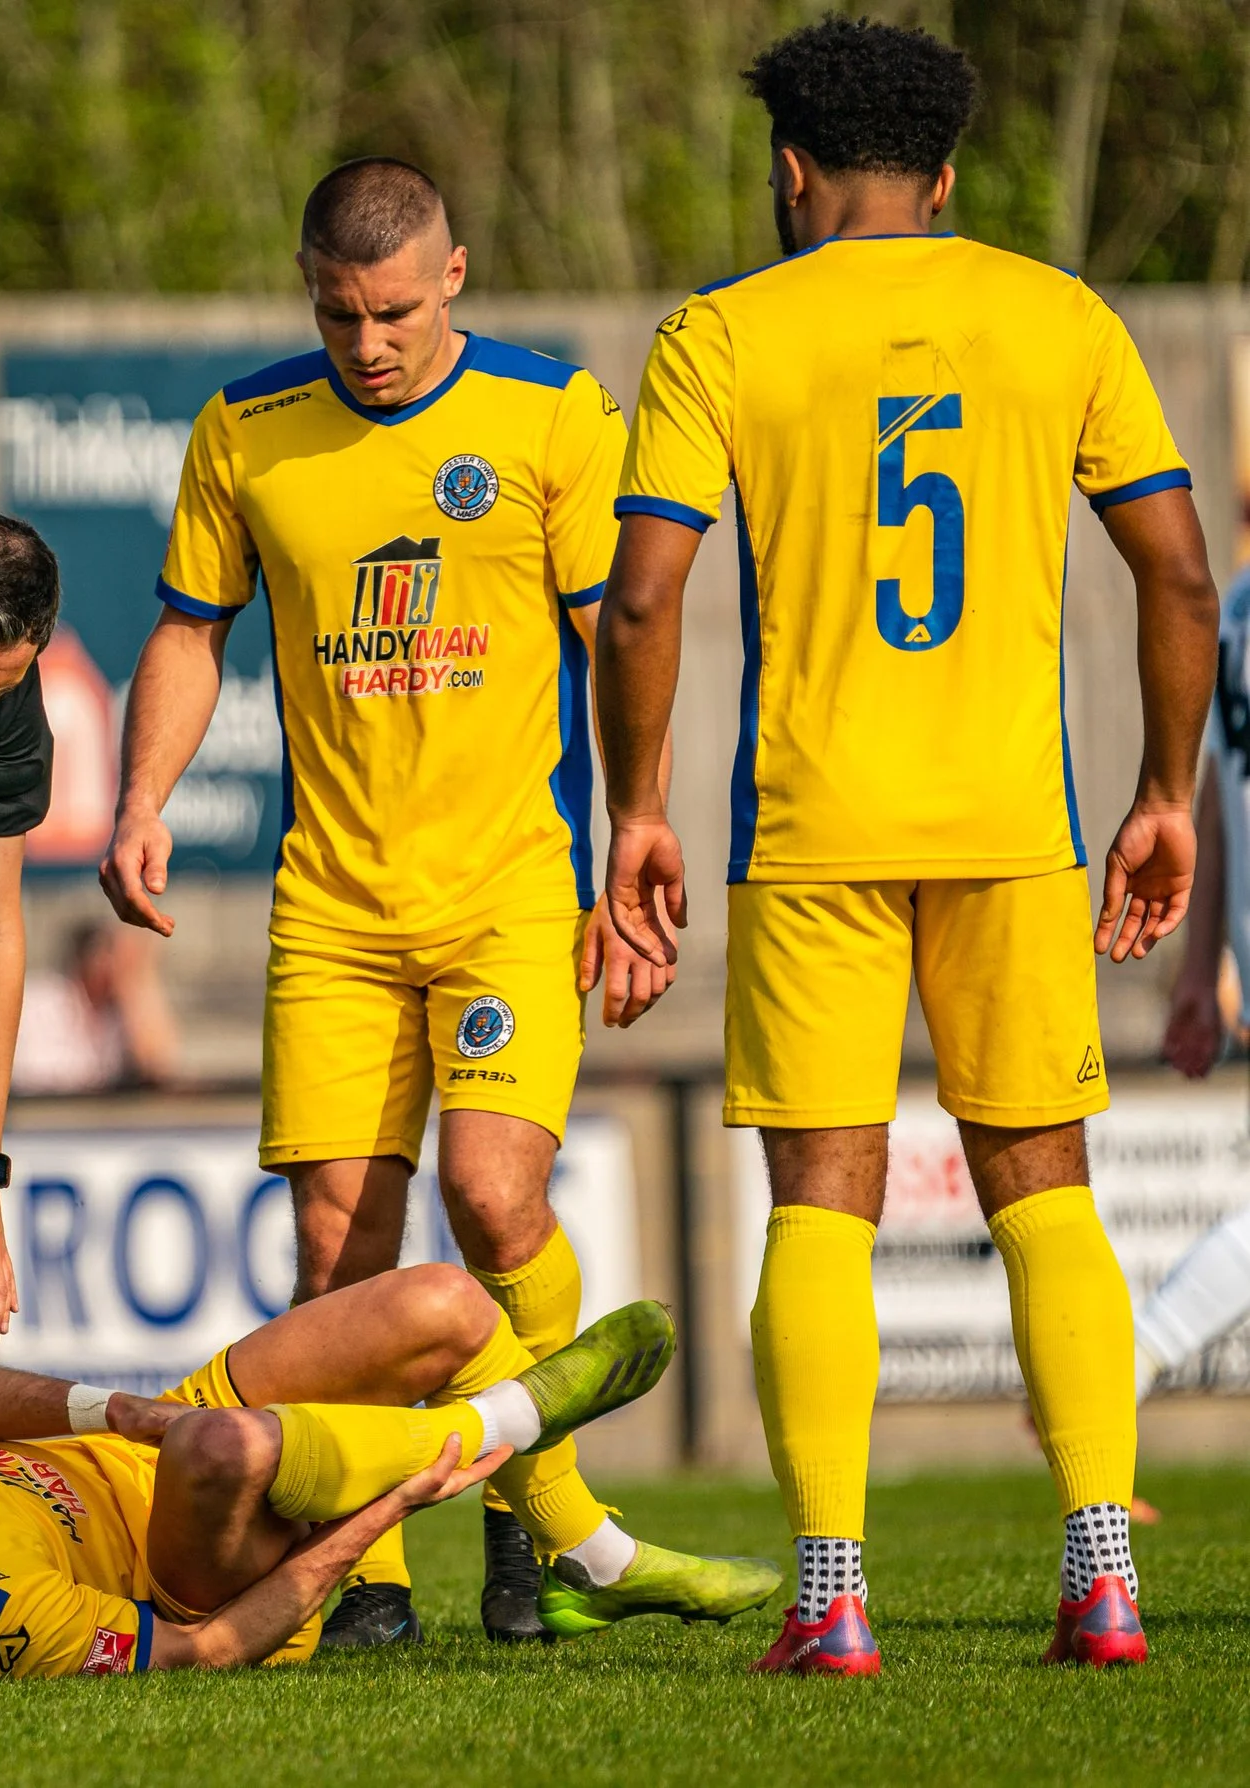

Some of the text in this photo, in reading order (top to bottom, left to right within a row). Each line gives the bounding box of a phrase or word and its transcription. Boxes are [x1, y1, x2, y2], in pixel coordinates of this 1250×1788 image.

[435, 456, 497, 495] DORCHESTER TOWN FC
[440, 499, 492, 518] THE MAGPIES
[876, 392, 965, 652] 5
[313, 624, 490, 665] HANDYMAN
[496, 1001, 513, 1022] TOWN
[460, 1038, 506, 1056] THE MAGPIES
